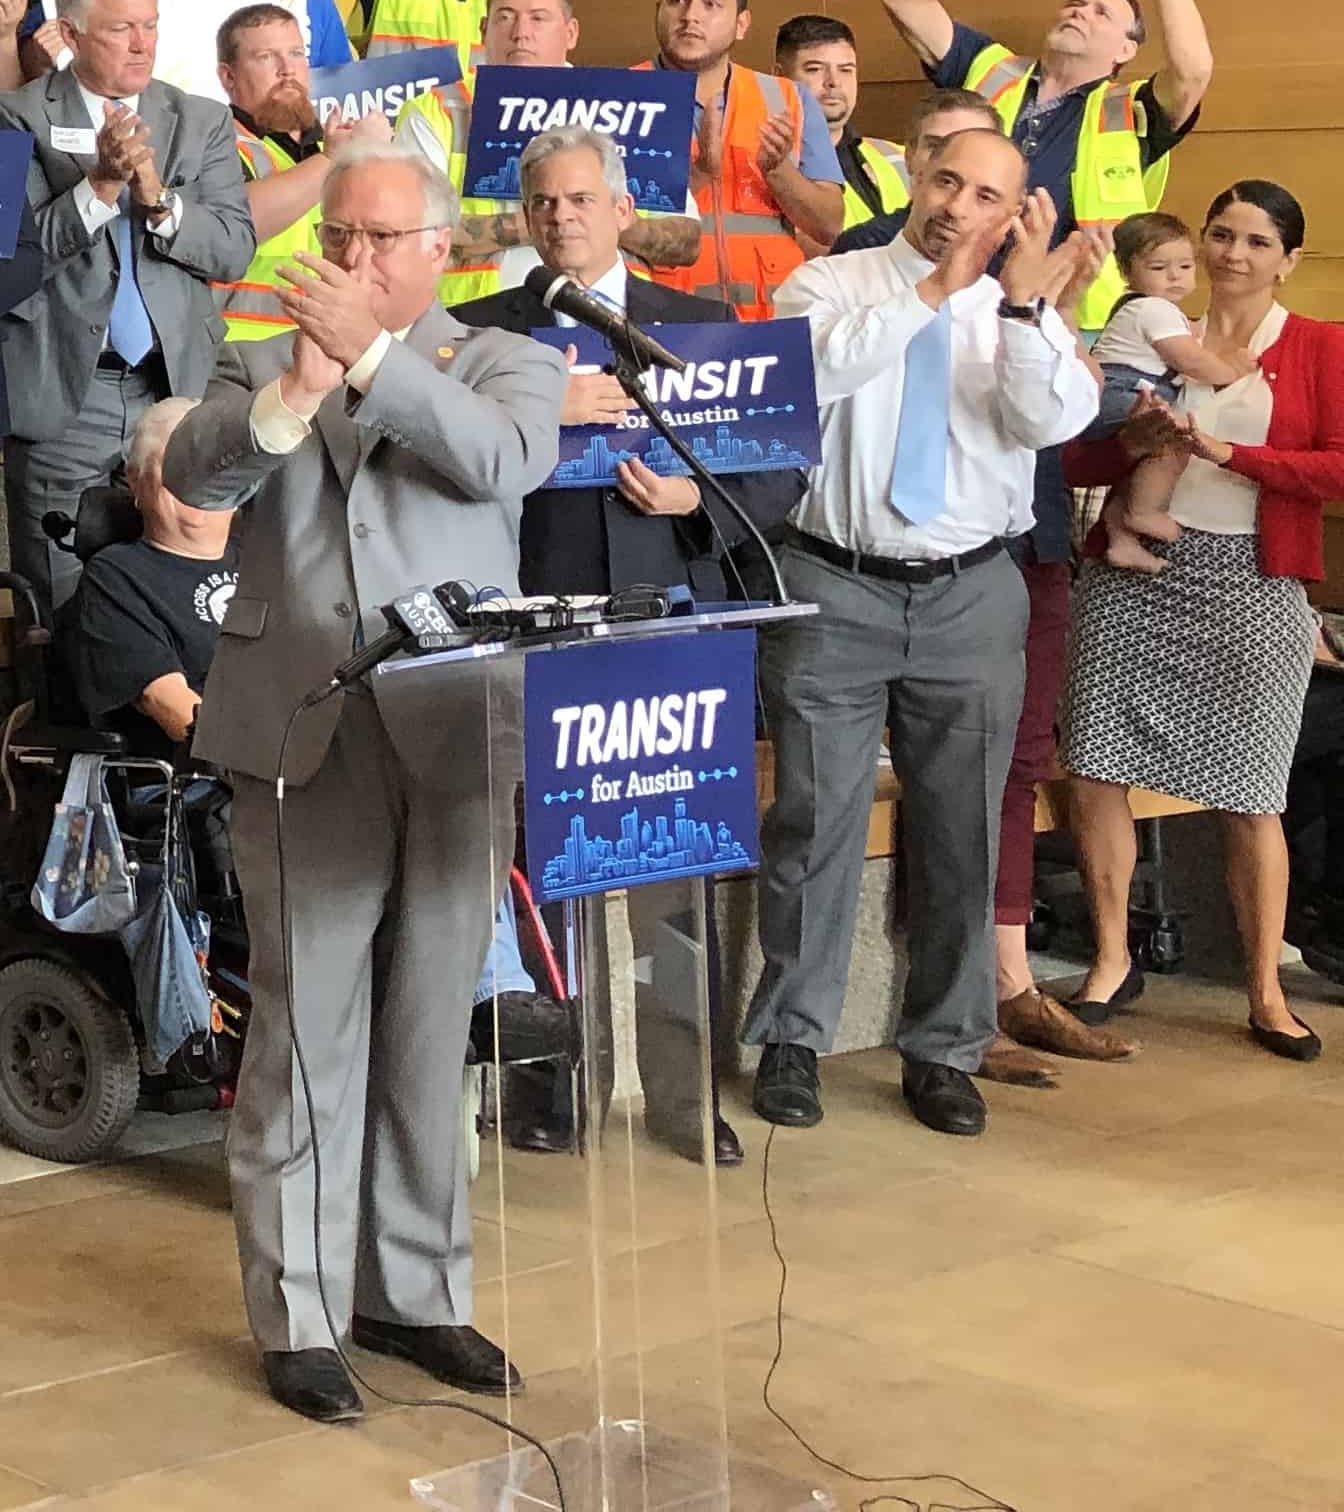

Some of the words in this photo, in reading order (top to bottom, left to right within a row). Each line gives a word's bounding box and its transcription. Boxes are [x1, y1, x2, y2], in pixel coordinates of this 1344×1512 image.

[499, 96, 666, 137] TRANSIT
[661, 406, 739, 427] Austin
[401, 602, 432, 634] AUST
[423, 606, 454, 634] CBS
[552, 688, 727, 769] TRANSIT
[591, 773, 621, 803] for
[625, 764, 694, 798] Austin
